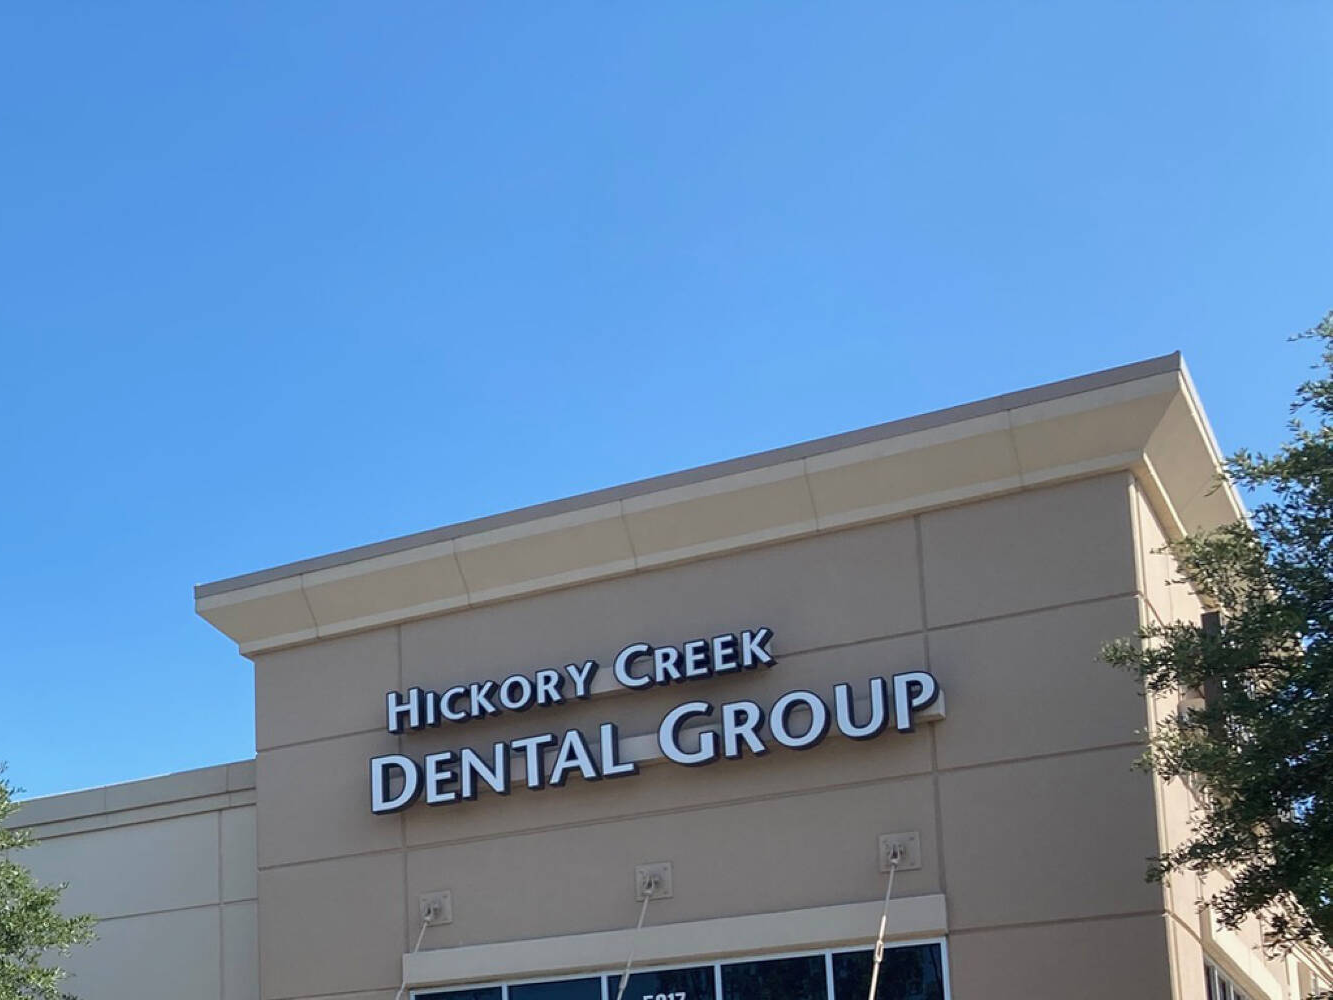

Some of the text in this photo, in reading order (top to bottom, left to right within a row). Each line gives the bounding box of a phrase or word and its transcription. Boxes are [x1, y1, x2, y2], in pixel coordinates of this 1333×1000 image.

[369, 671, 941, 814] DENTAL GROUP
[385, 628, 778, 734] HICKORY CREEK
